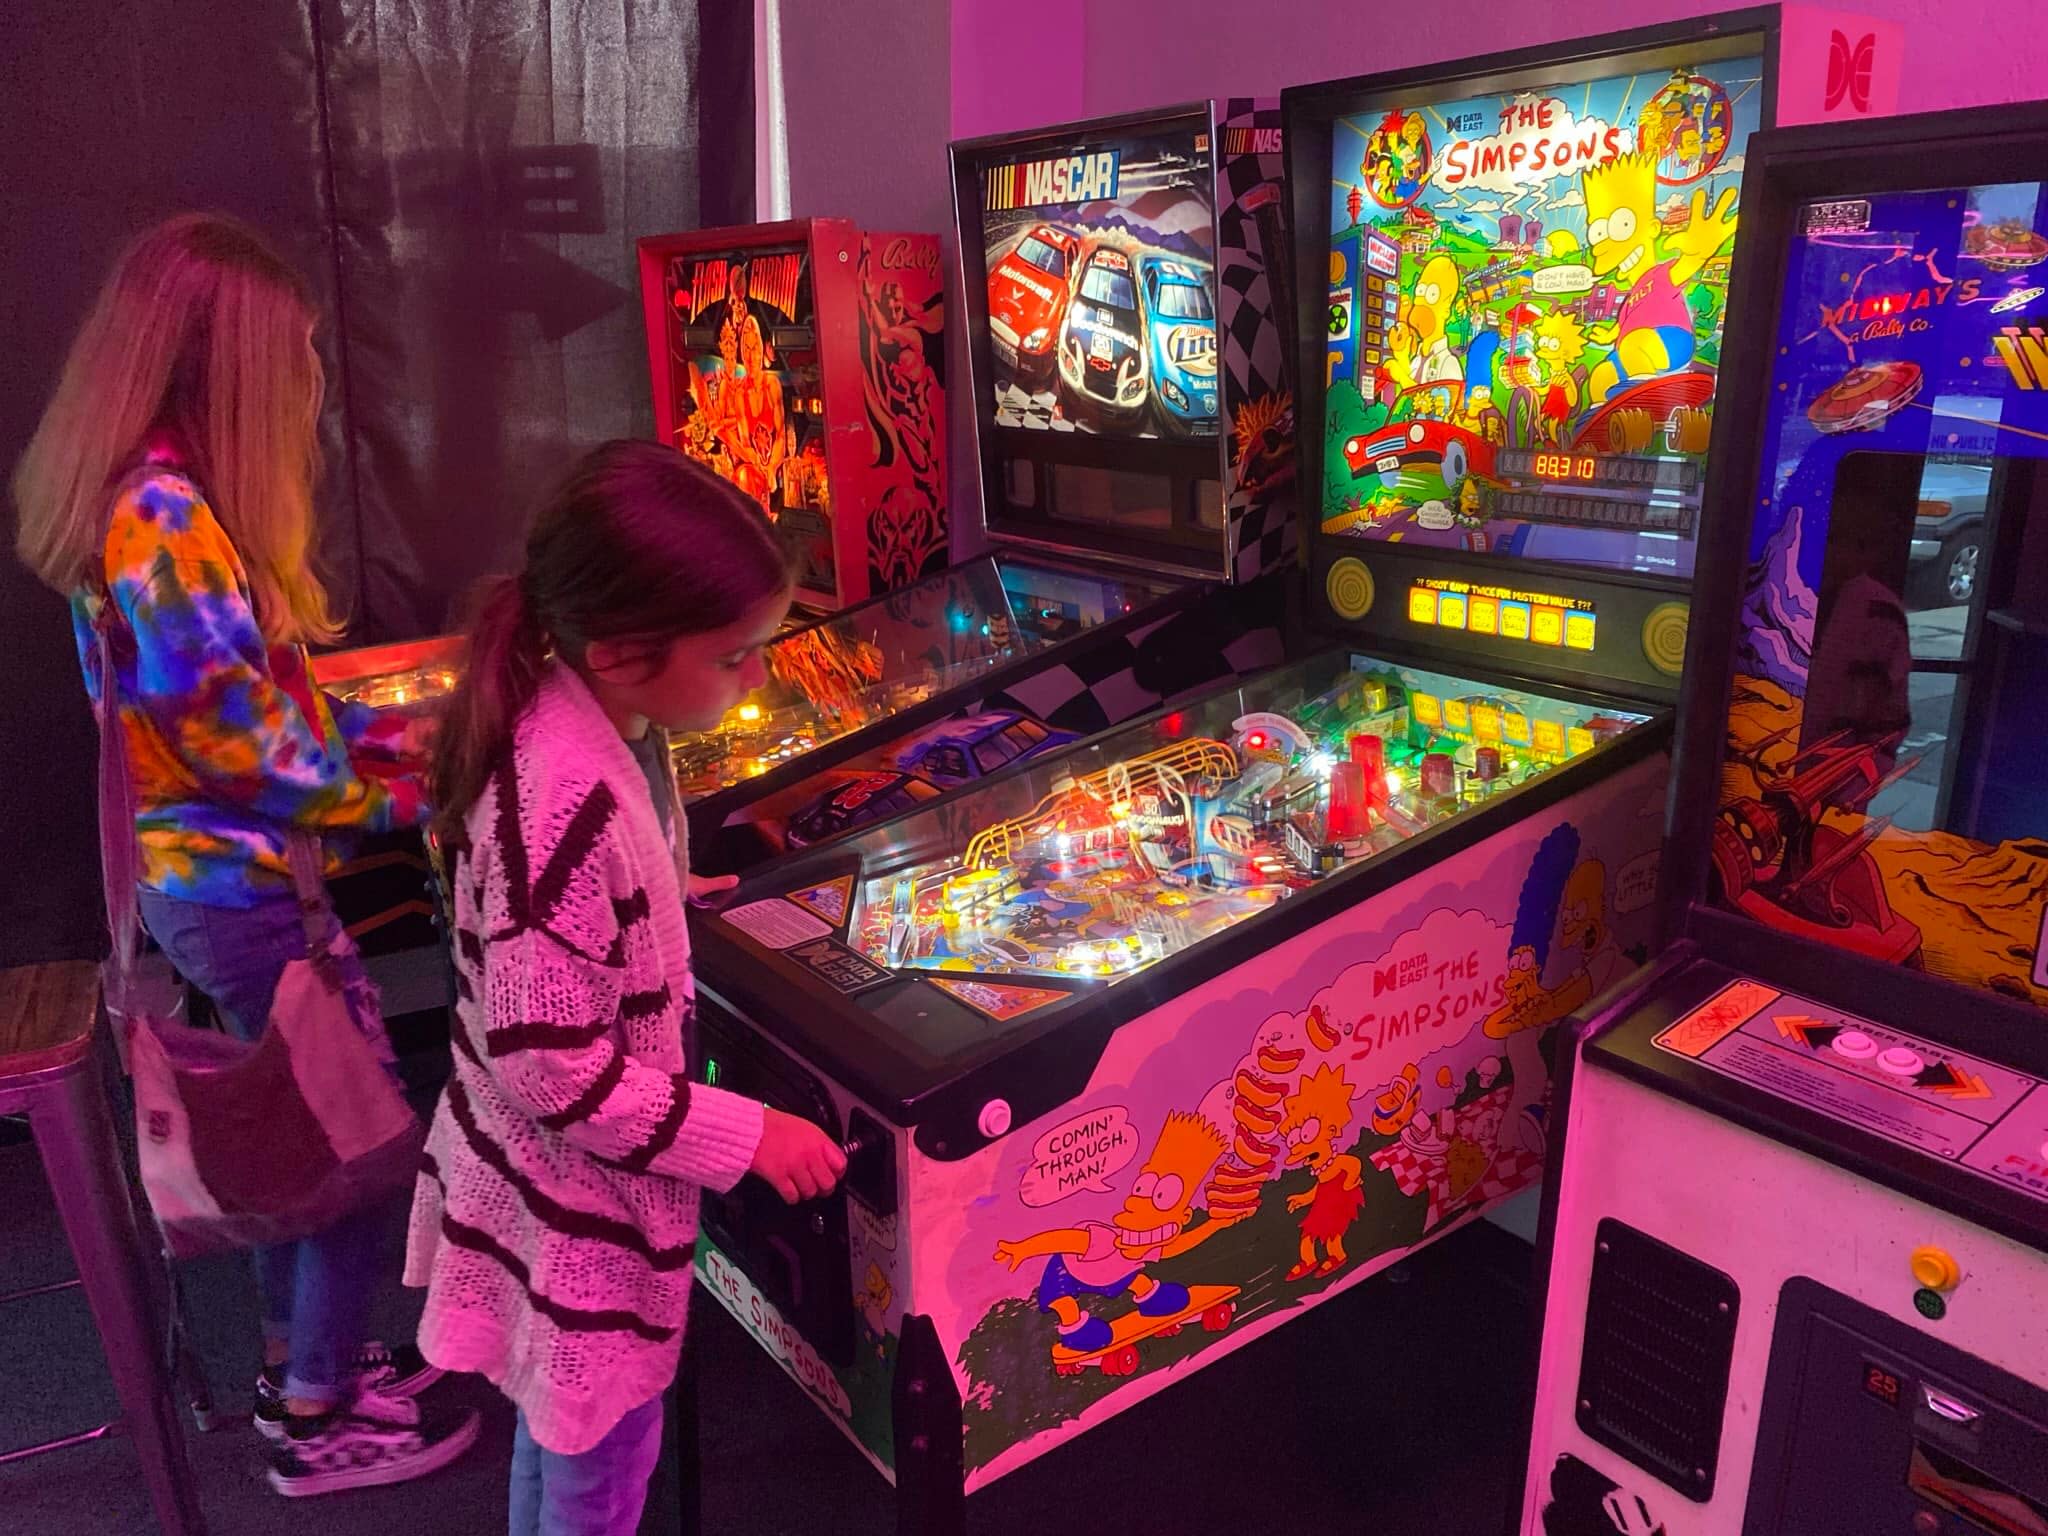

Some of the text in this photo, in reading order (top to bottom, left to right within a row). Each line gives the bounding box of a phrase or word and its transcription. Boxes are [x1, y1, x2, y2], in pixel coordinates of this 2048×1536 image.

[1463, 113, 1483, 121] DATA
[1463, 122, 1483, 130] EAST
[1500, 98, 1553, 135] THE
[1445, 127, 1620, 183] SIMPSONS
[1025, 152, 1114, 206] NASCAR
[880, 240, 941, 278] Bally
[690, 254, 800, 325] FLASH GORDON
[998, 265, 1054, 304] Motorcraft
[1628, 280, 1655, 306] TILT
[1072, 313, 1139, 351] oodwrench
[1863, 320, 1905, 340] Bally
[1909, 318, 1934, 332] Co.
[1471, 585, 1496, 597] TWICE
[1513, 592, 1549, 605] MYSTERY
[1550, 596, 1575, 608] VALUE
[821, 965, 860, 987] EAST
[837, 958, 877, 979] DATA
[1400, 952, 1428, 971] DATA
[1400, 967, 1428, 988] EAST
[1434, 951, 1479, 990] THE
[1351, 974, 1507, 1060] SIMPSONS
[1840, 1019, 1898, 1042] LASER
[1049, 1114, 1112, 1154] COMIN'
[1059, 1157, 1106, 1191] MAN!
[710, 1255, 742, 1303] THE
[752, 1295, 839, 1404] SIMPSONS
[1871, 1369, 1897, 1393] 25
